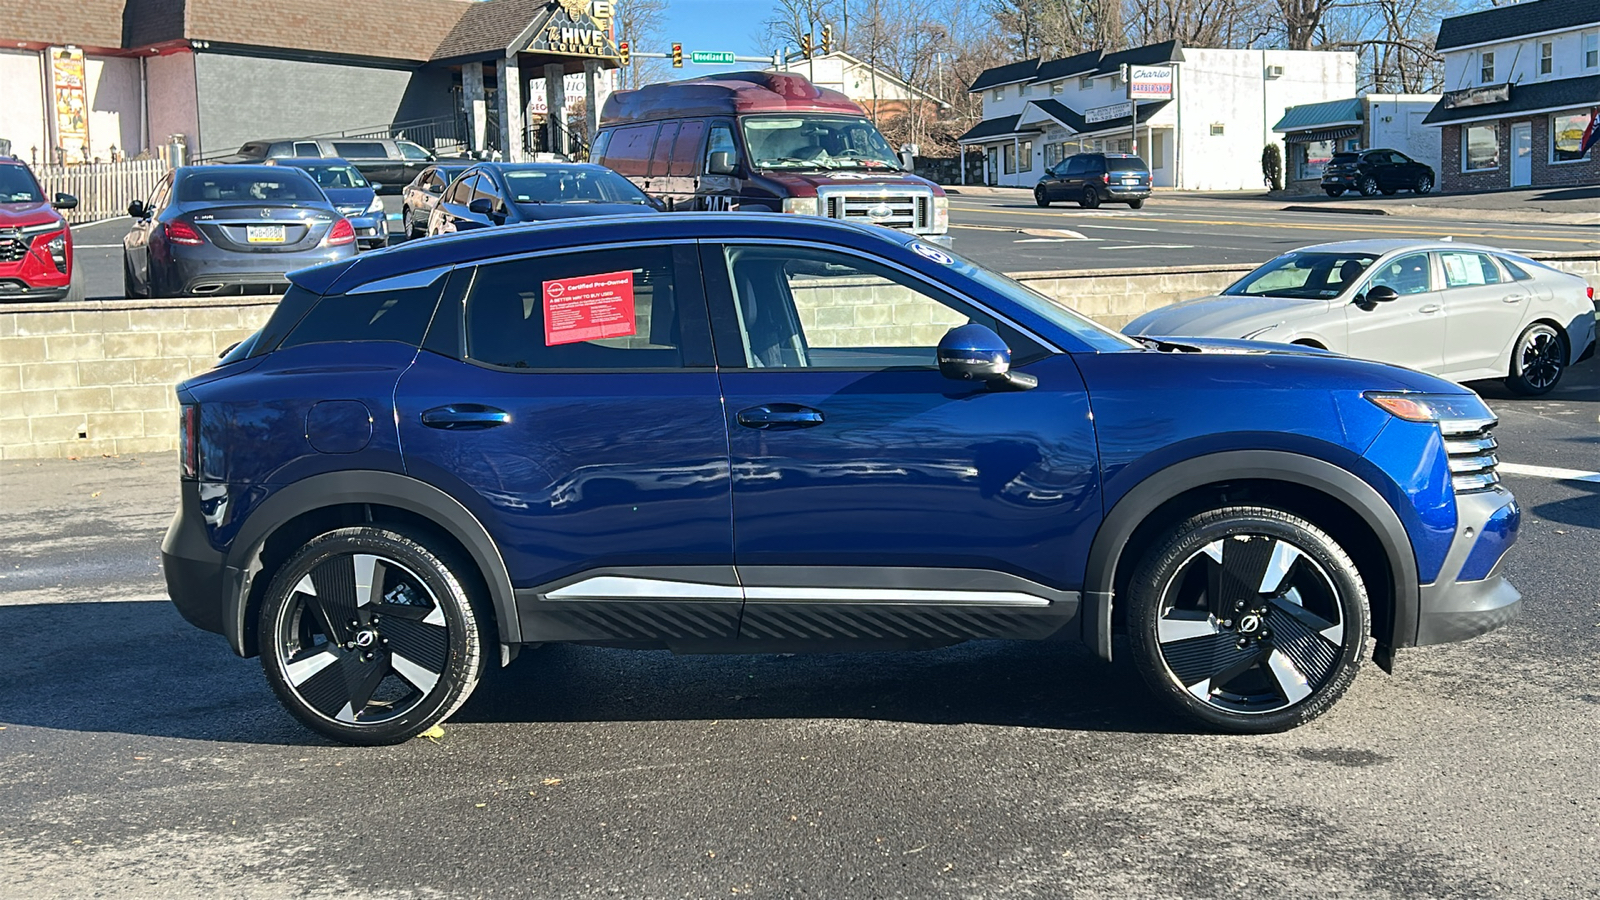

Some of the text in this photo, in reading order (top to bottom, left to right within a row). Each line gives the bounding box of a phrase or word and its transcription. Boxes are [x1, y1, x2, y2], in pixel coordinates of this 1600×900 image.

[547, 25, 603, 47] The HIVE
[550, 43, 603, 55] LOUNGE
[694, 53, 723, 61] Woodland
[1133, 70, 1170, 79] Charles
[1132, 83, 1170, 92] BARBER SHOP
[567, 278, 628, 291] Certified Pre-Owned
